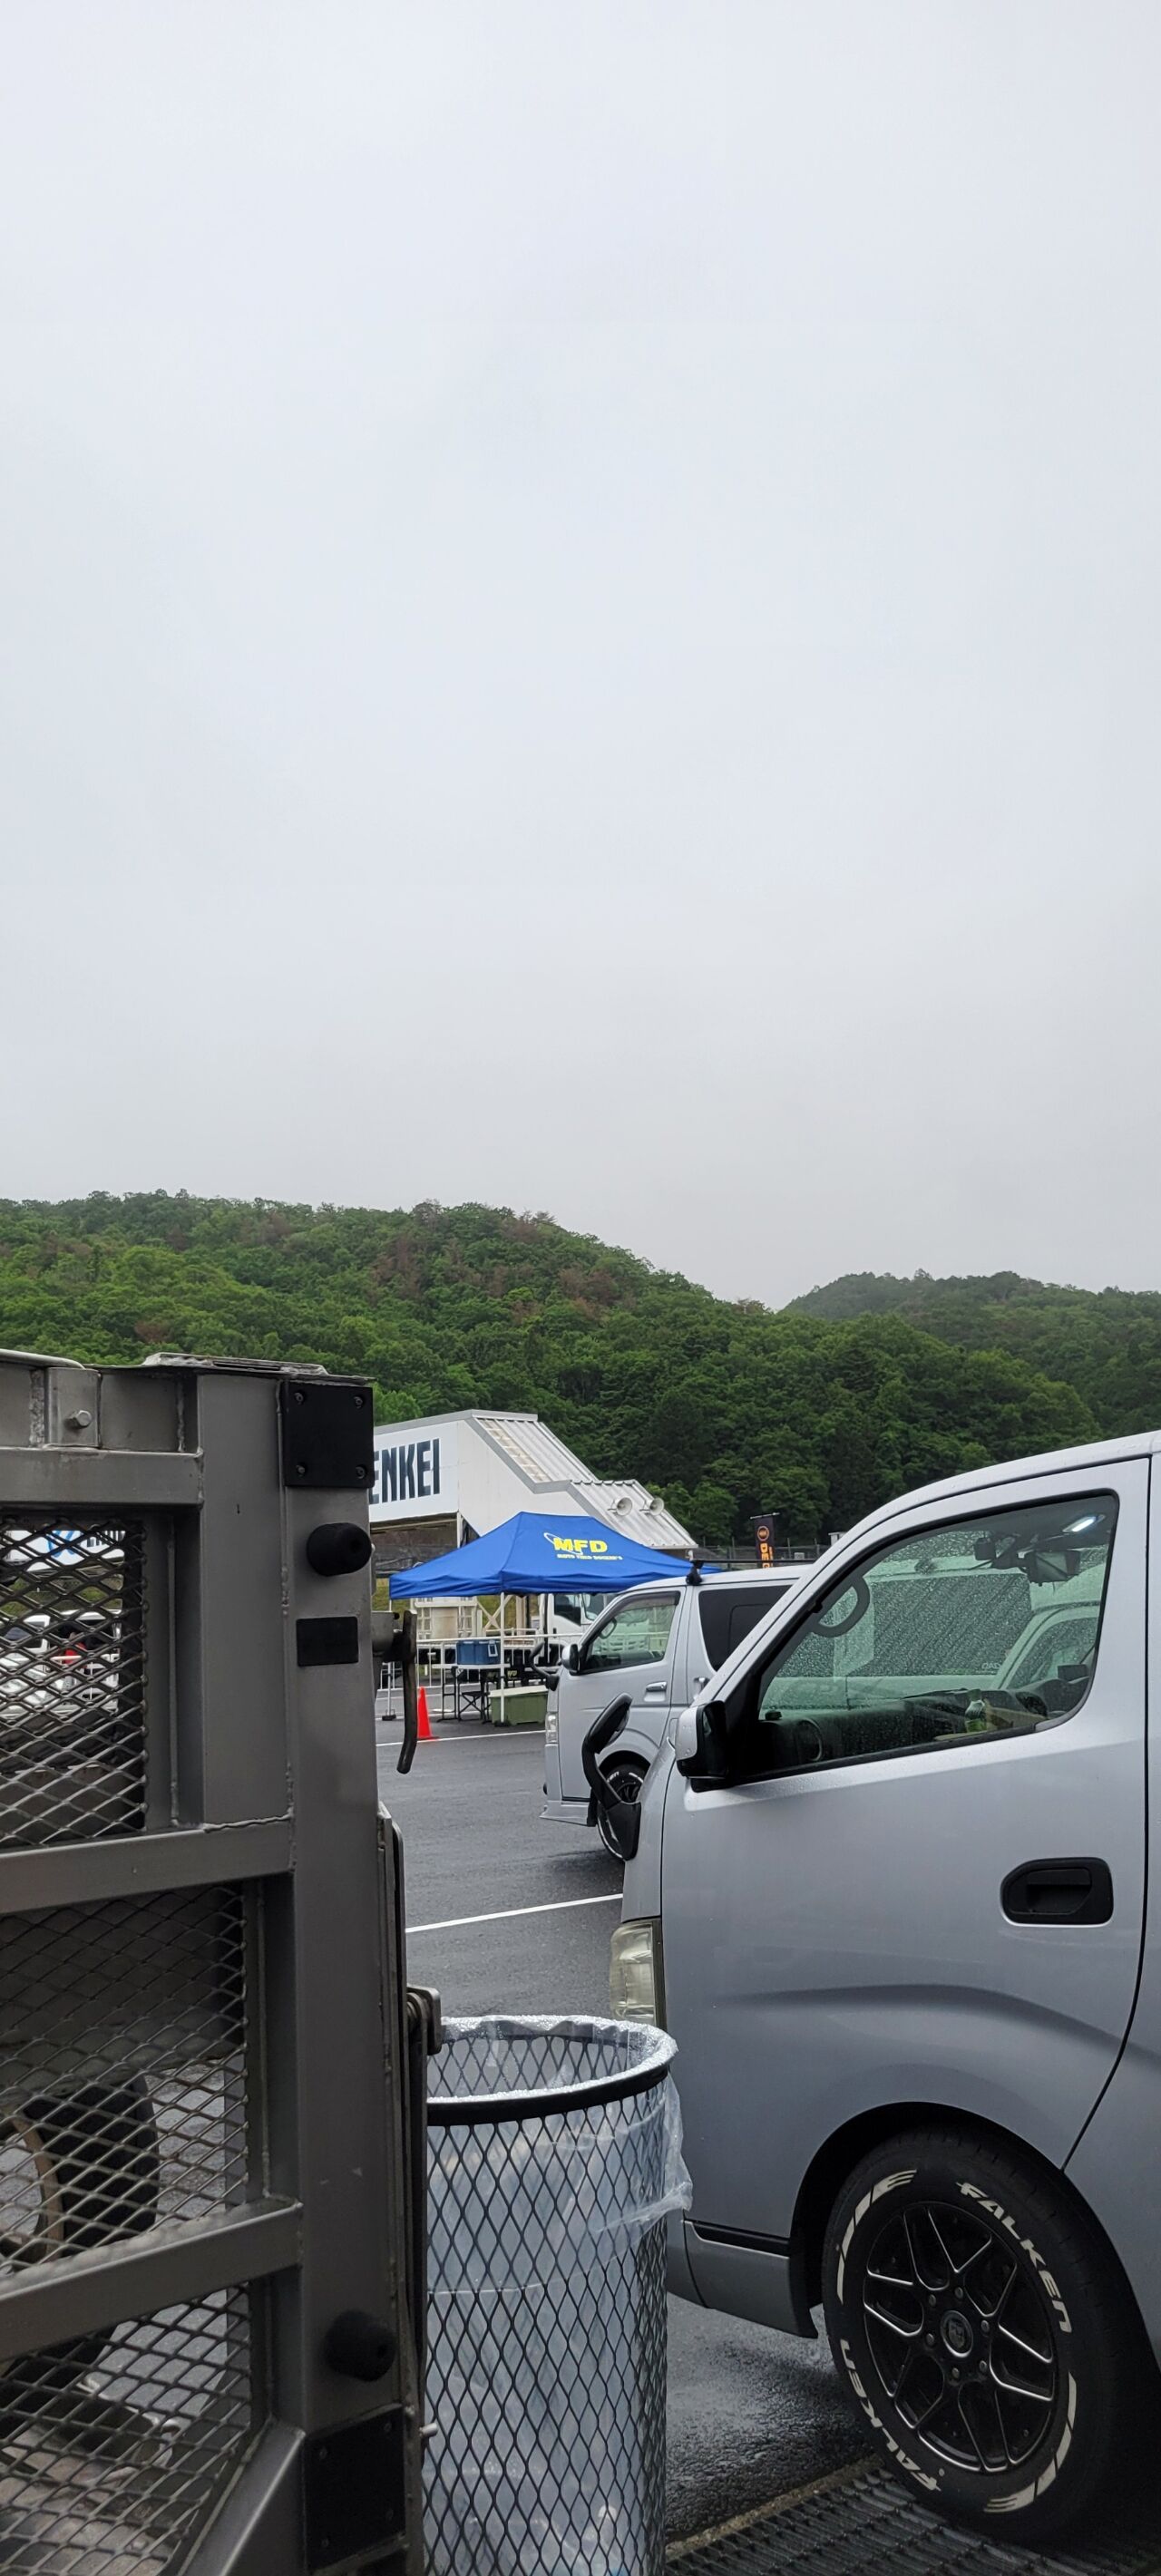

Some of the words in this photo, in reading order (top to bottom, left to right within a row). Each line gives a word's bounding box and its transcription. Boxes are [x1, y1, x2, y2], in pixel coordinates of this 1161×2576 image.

[553, 1537, 608, 1553] MFD
[956, 2182, 1072, 2333] FALKEN
[840, 2338, 942, 2492] FALKEN
